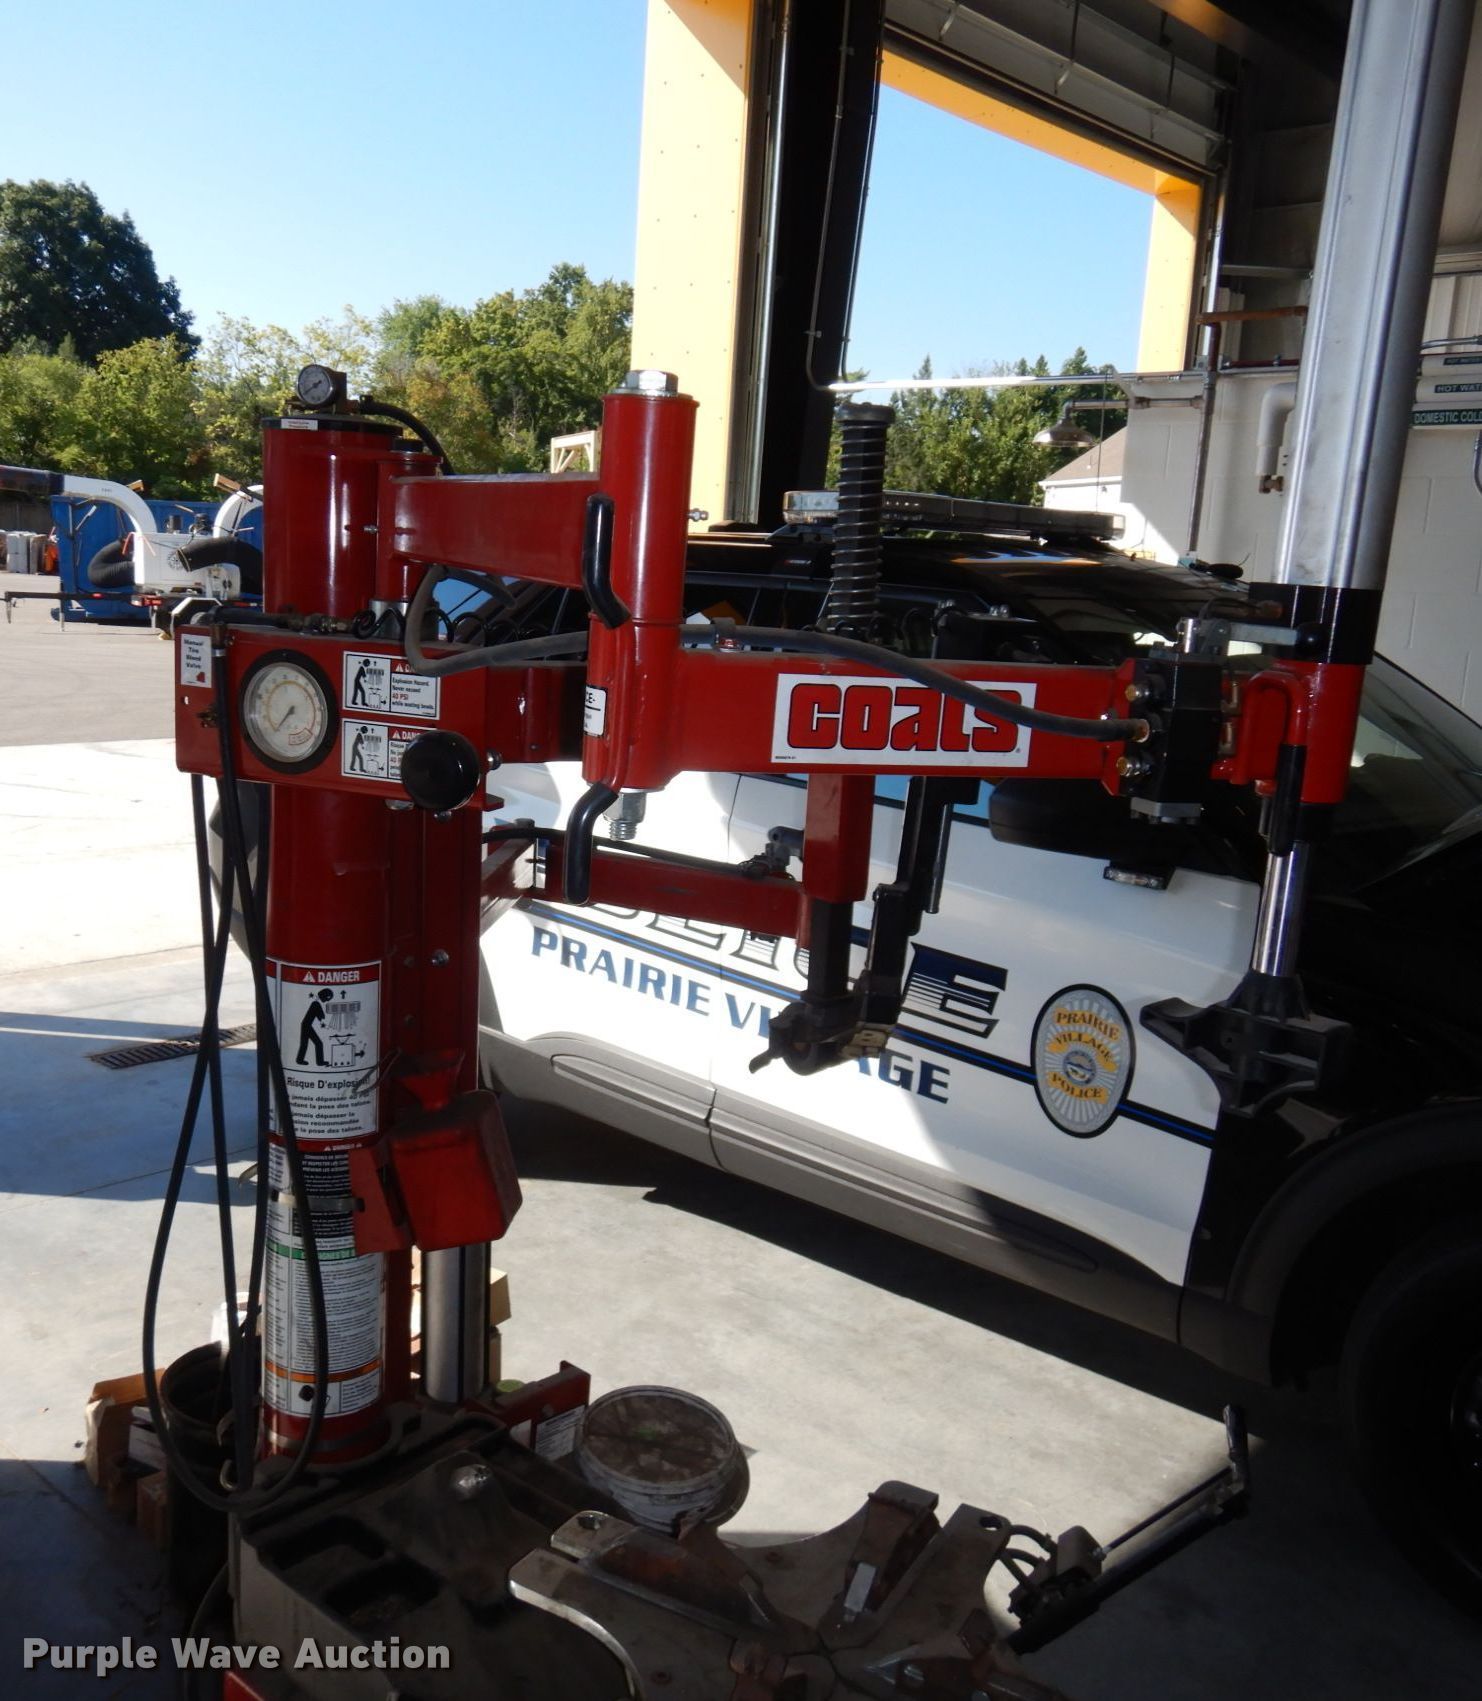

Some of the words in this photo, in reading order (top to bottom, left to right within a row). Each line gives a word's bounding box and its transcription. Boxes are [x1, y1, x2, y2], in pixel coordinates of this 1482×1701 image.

[1414, 412, 1458, 423] DOMESTIC
[318, 970, 360, 983] DANGER
[531, 927, 711, 1016] PRAIRIE
[725, 992, 951, 1104] VIGE
[1056, 1012, 1120, 1041] PRAIRIE
[1055, 1032, 1114, 1062] VILLAGE
[287, 1077, 315, 1089] Risque
[1052, 1073, 1102, 1098] POLICE
